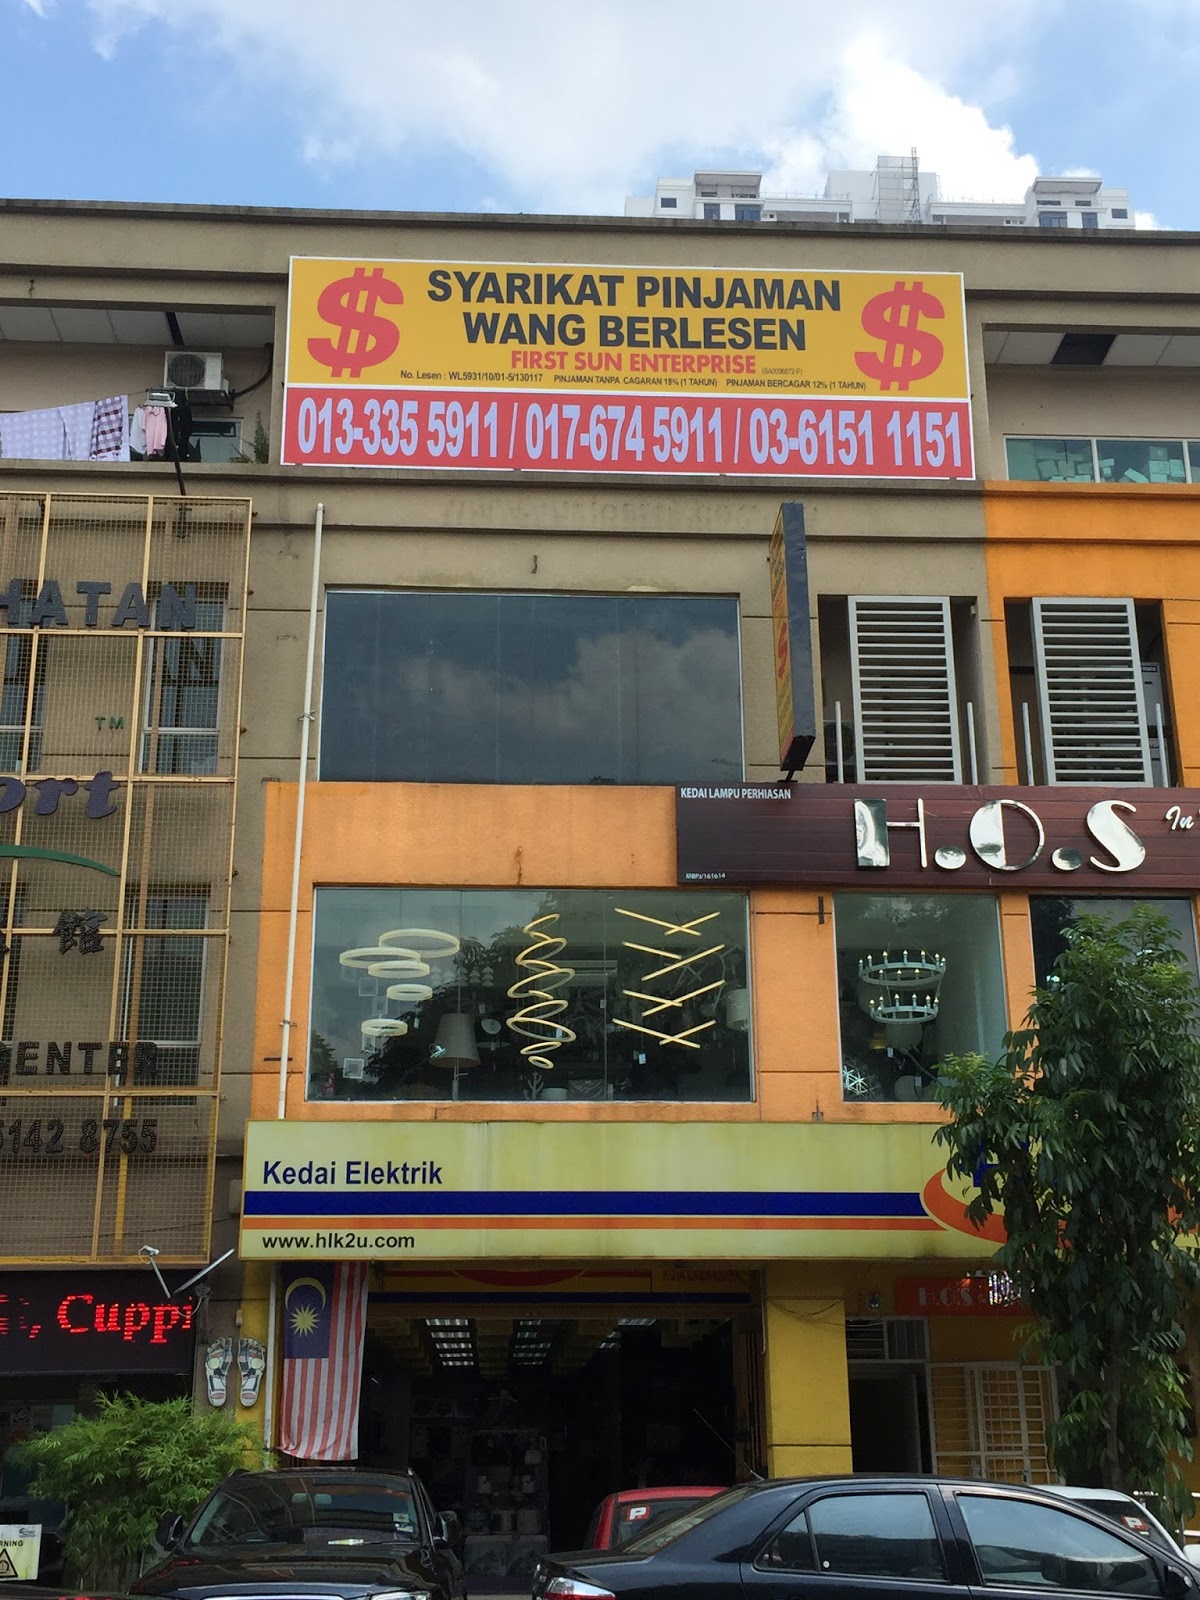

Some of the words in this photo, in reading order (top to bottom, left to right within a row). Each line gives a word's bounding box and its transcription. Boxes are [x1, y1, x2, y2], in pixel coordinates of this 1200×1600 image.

[427, 270, 625, 307] SYARIKAT
[636, 276, 841, 311] PINJAMAN
[463, 312, 586, 347] WANG
[599, 315, 806, 351] BERLESEN
[511, 350, 569, 370] FIRST
[574, 351, 623, 372] SUN
[629, 353, 756, 374] ENTERPRISE
[400, 370, 415, 379] No.
[416, 371, 442, 380] Lesen
[553, 374, 594, 384] PINJAMAN
[594, 375, 621, 384] TANPA
[623, 376, 663, 386] CAGARAN
[664, 377, 680, 386] 18%
[688, 378, 718, 388] TAHUN)
[726, 379, 766, 388] PINJAMAN
[767, 380, 811, 389] BERCAGAR
[813, 381, 828, 389] 12%
[837, 382, 867, 391] TAHUN)
[297, 397, 419, 456] 013-335
[427, 400, 498, 458] 5911
[525, 403, 645, 462] 017-674
[652, 406, 723, 464] 5911
[749, 408, 874, 466] 03-6151
[886, 410, 962, 468] 1151
[94, 716, 124, 731] TM
[680, 787, 708, 799] KEDAI
[708, 788, 740, 799] LAMPU
[741, 788, 792, 799] PERHIASAN
[80, 1118, 159, 1153] 8755
[262, 1160, 337, 1185] Kedai
[345, 1160, 444, 1186] Elektrik
[262, 1233, 416, 1249] www.hlk2u.com
[630, 1506, 647, 1520] P
[1124, 1516, 1143, 1528] P
